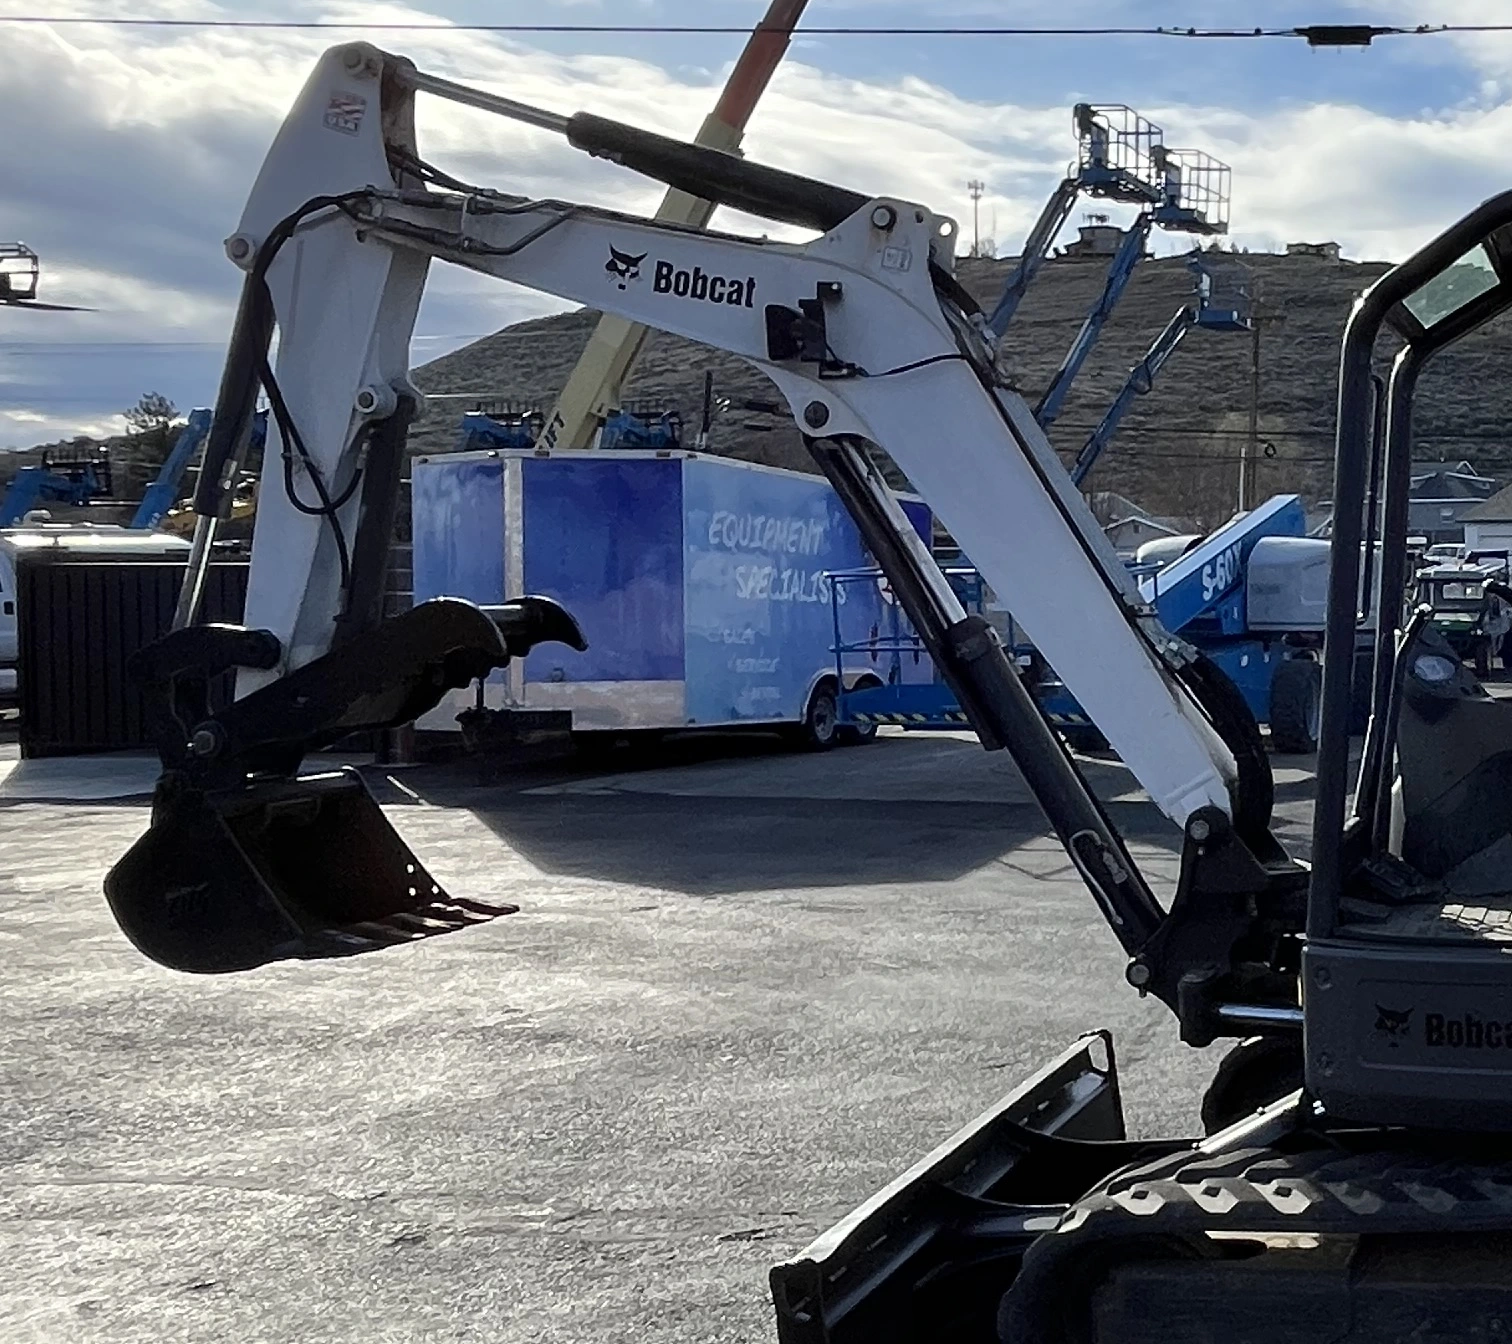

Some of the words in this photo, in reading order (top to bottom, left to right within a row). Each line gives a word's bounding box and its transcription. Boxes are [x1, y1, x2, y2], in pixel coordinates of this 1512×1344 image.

[653, 260, 756, 308] Bobcat
[543, 410, 566, 449] IFT
[708, 510, 825, 555] EQUIPMENT
